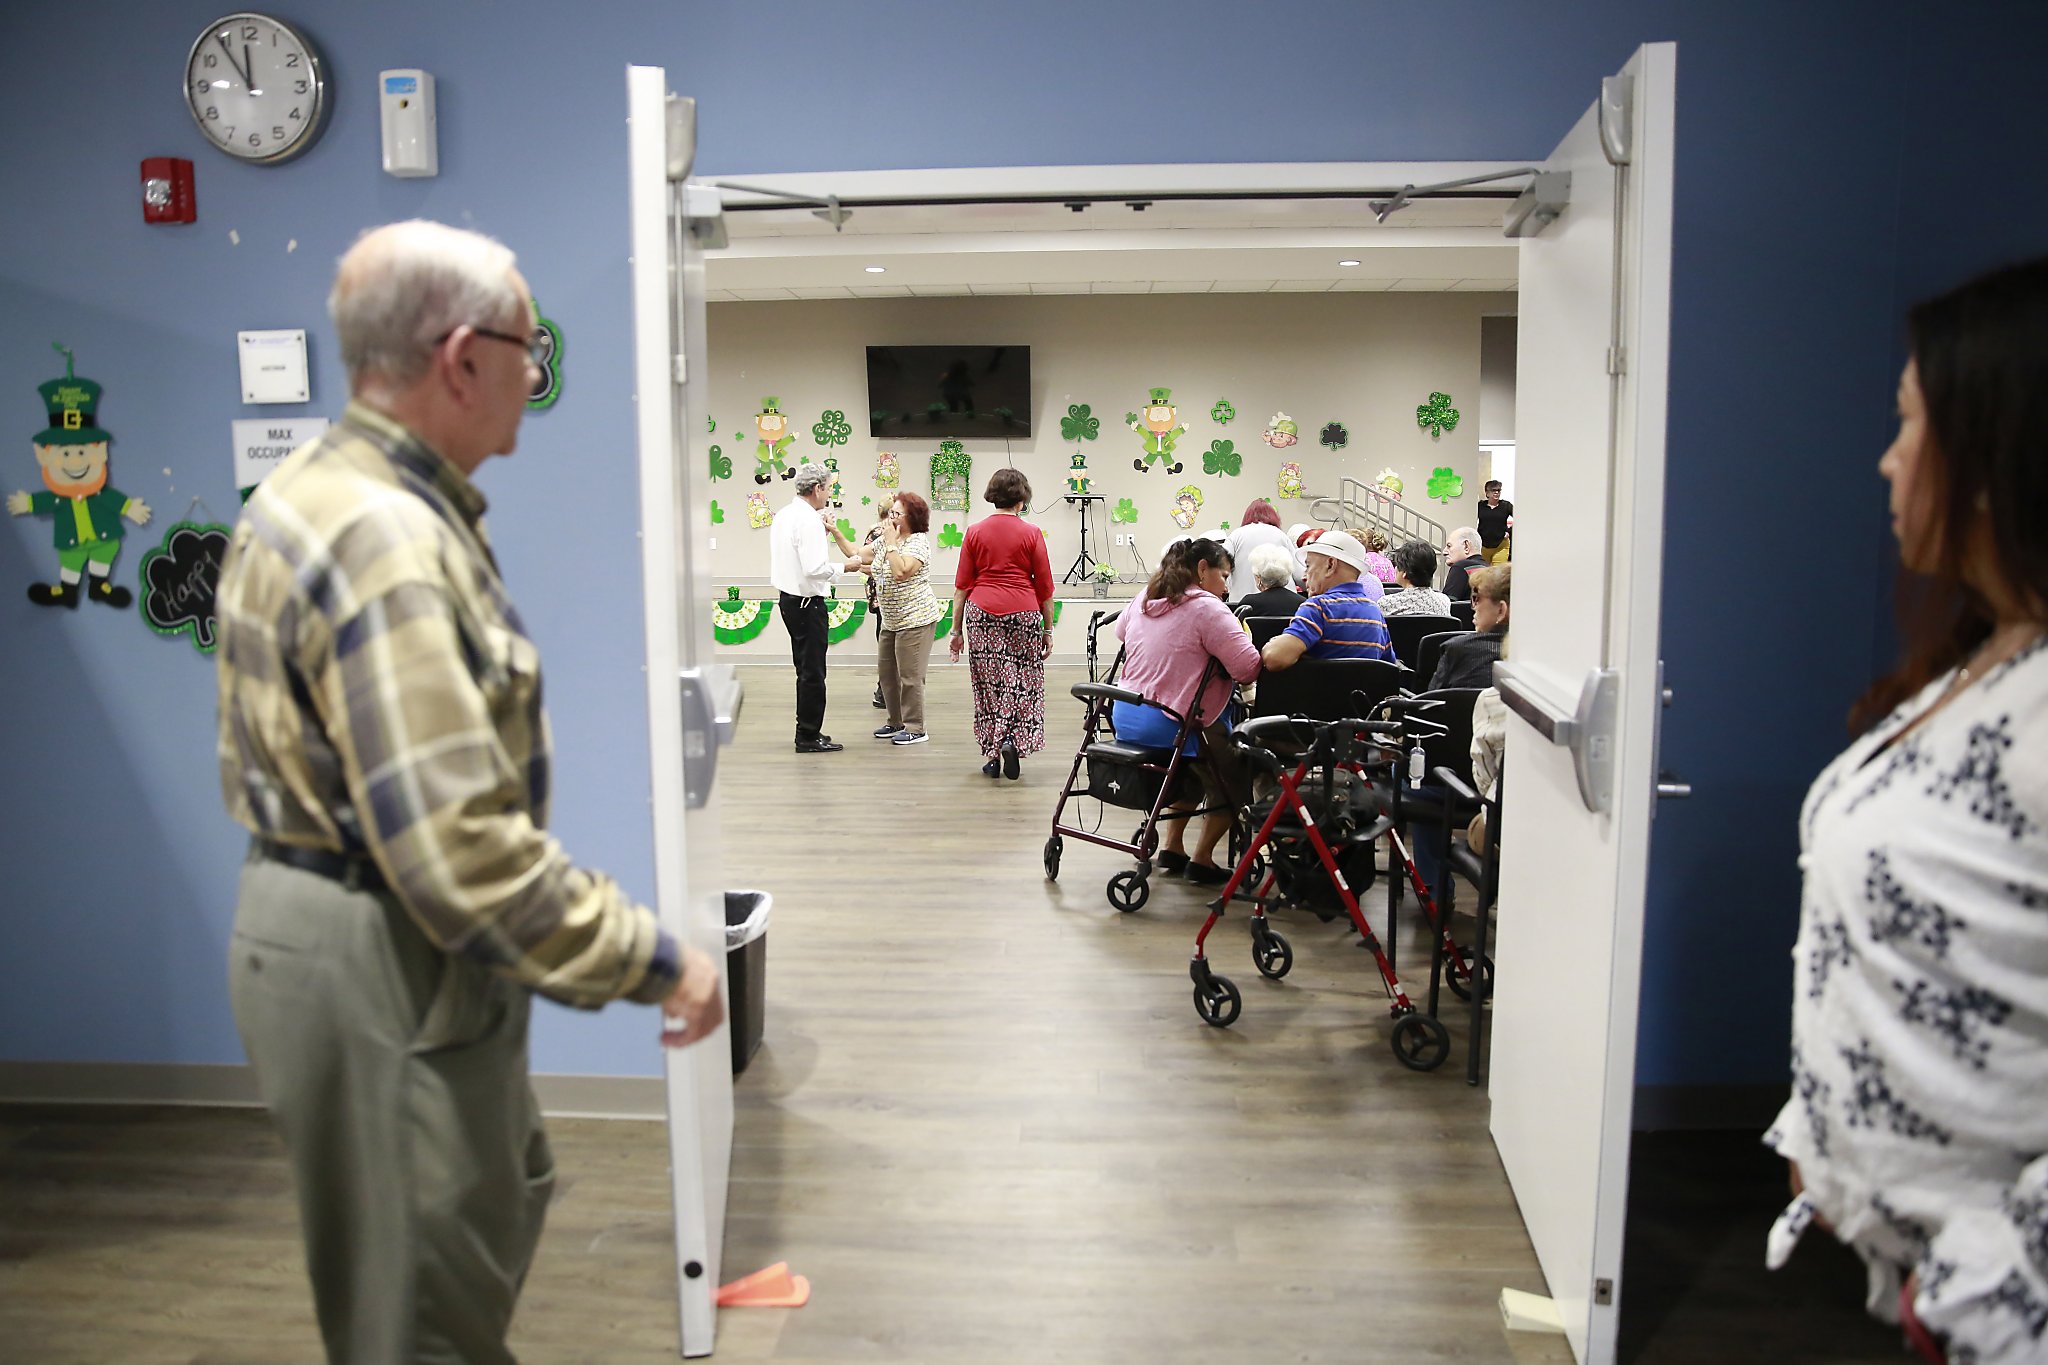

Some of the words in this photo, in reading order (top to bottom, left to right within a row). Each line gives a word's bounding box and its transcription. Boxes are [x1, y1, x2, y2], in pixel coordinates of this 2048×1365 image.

[241, 26, 258, 41] 12
[272, 34, 277, 47] 1
[203, 54, 217, 68] 10
[286, 54, 299, 68] 2
[197, 80, 210, 93] 9
[294, 81, 308, 94] 3
[206, 107, 219, 120] 8
[289, 107, 301, 121] 4
[226, 127, 236, 139] 7
[248, 133, 261, 146] 6
[273, 127, 285, 140] 5
[267, 429, 293, 440] MAX
[247, 446, 296, 459] OCCUPA
